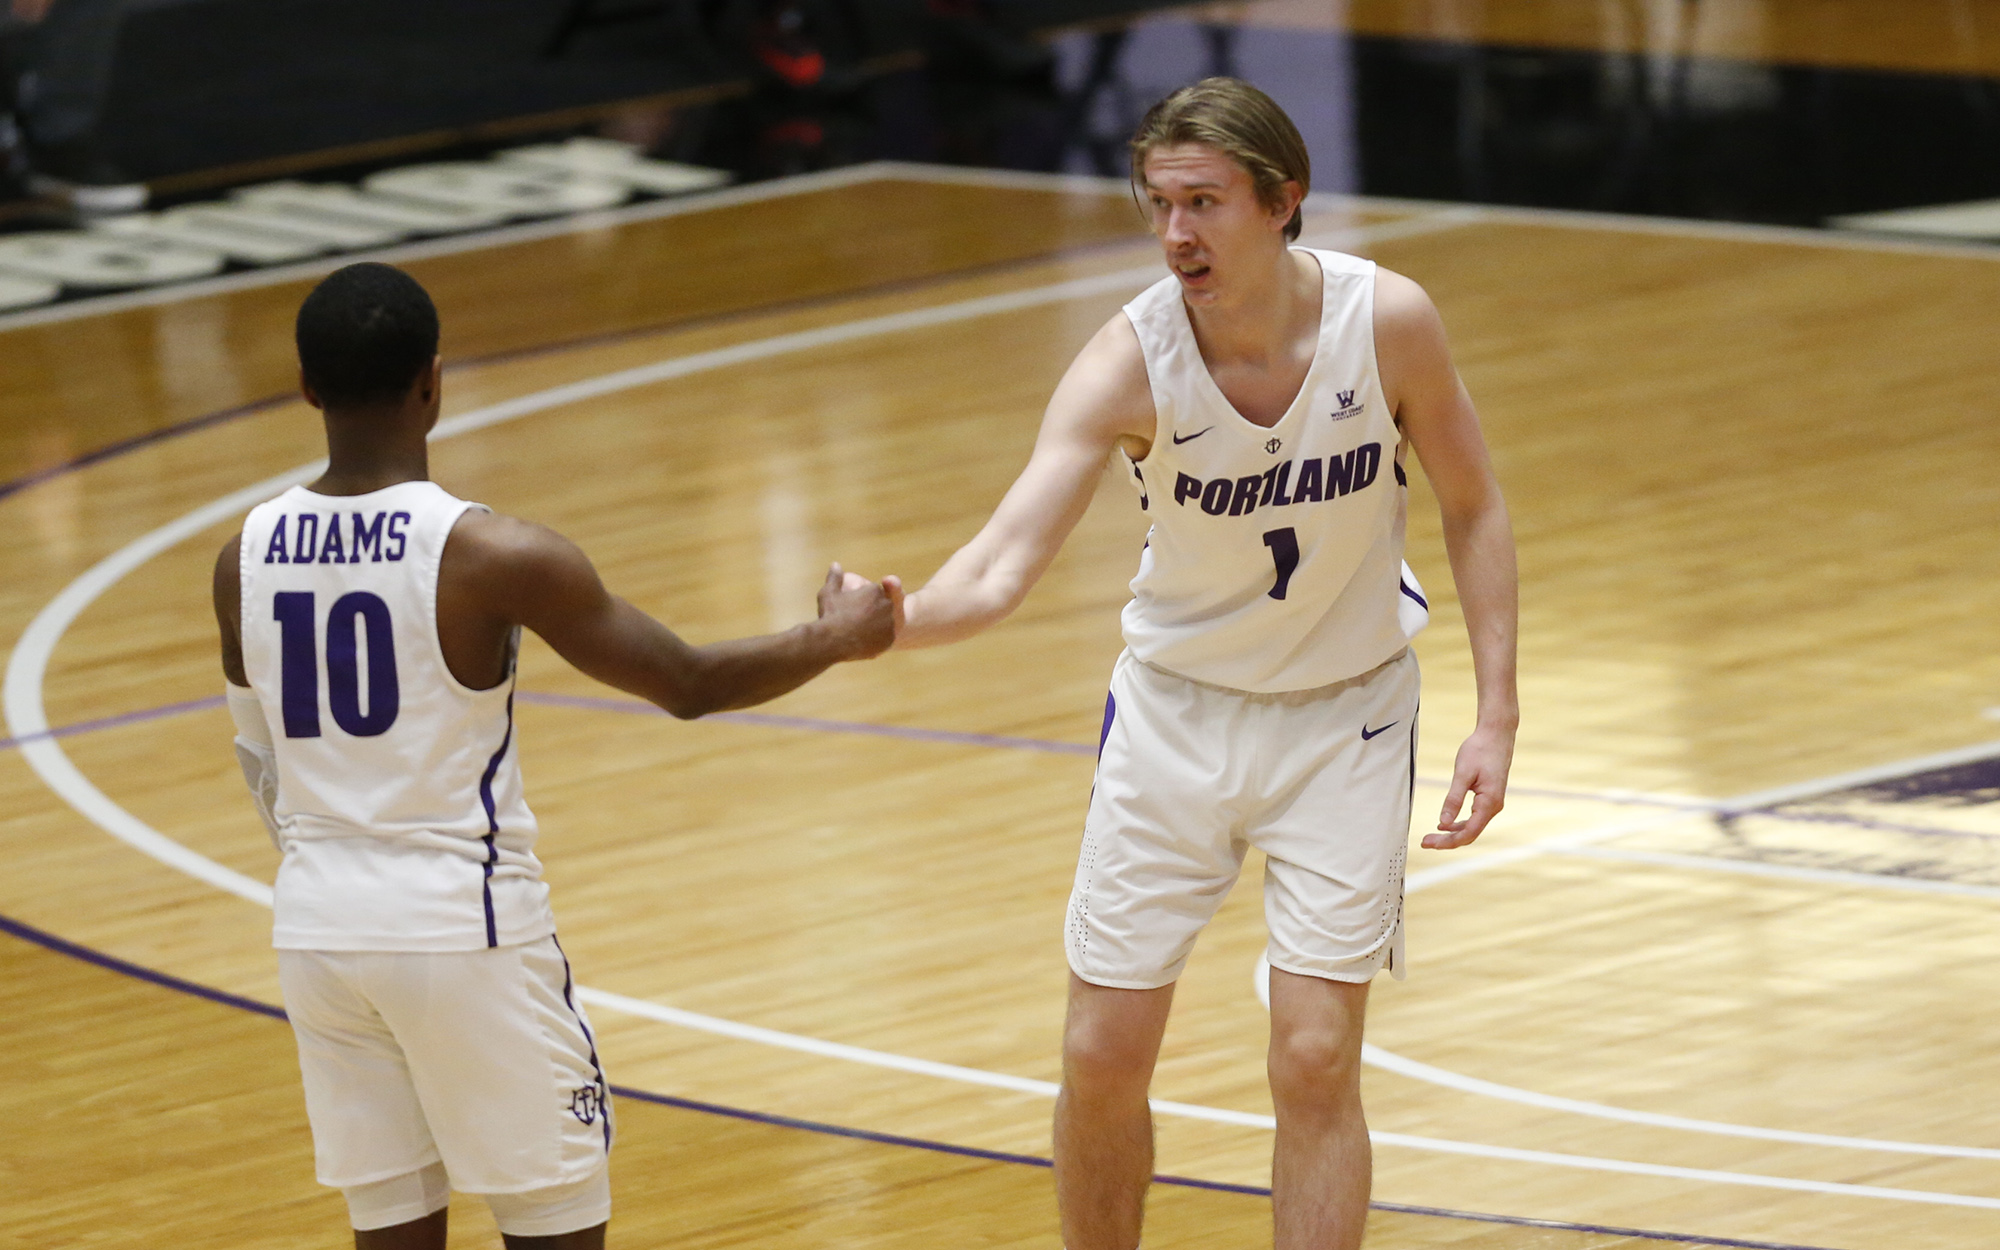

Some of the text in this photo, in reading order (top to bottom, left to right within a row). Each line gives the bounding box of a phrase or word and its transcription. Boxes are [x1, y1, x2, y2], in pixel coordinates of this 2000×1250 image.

[1174, 442, 1382, 516] PORTLAND
[264, 511, 412, 564] ADAMS
[1262, 527, 1300, 600] 1
[273, 591, 400, 738] 10
